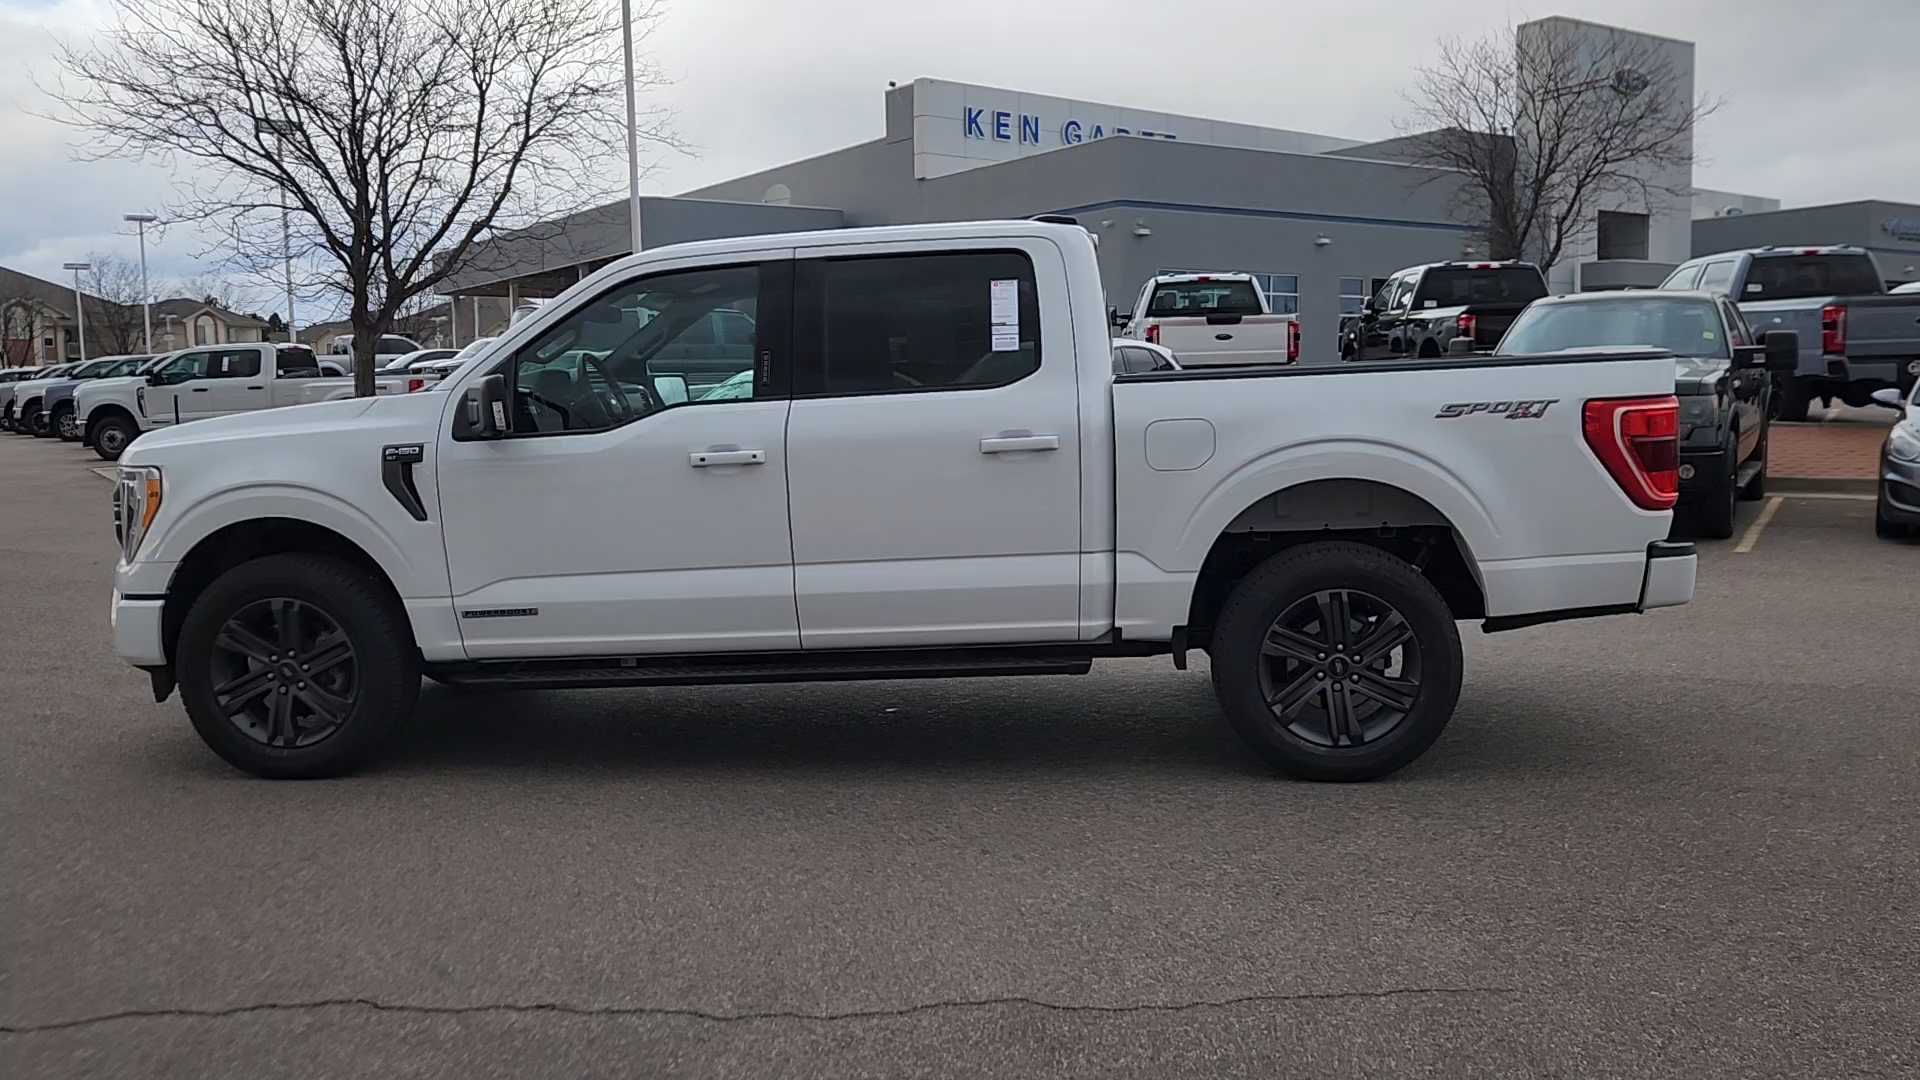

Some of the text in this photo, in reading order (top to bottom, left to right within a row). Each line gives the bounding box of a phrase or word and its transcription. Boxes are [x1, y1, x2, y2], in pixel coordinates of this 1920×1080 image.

[965, 106, 1040, 145] KEN
[1434, 399, 1560, 418] SPORT
[385, 446, 420, 455] F-150
